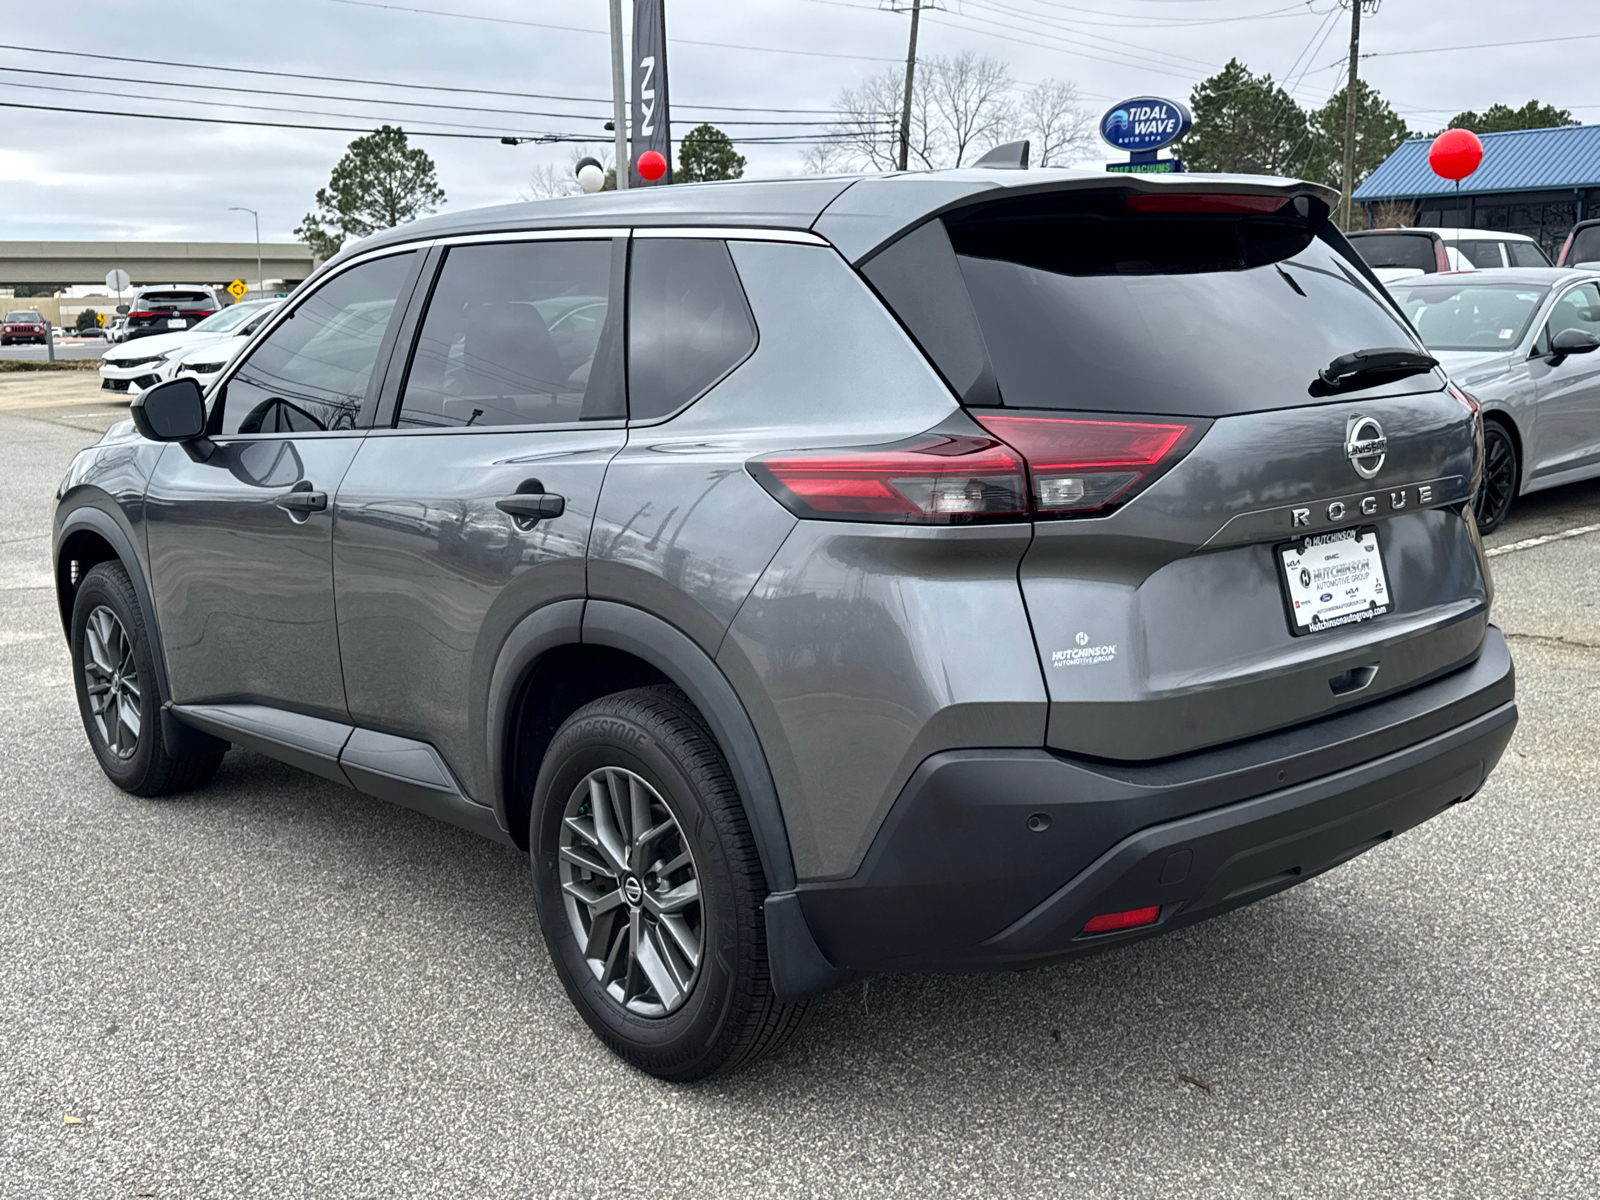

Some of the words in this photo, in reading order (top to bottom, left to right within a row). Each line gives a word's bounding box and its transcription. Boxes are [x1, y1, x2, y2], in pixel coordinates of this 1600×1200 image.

[1129, 106, 1167, 121] TIDAL
[1134, 120, 1175, 135] WAVE
[1131, 163, 1170, 173] VACUUMS
[1292, 486, 1432, 527] ROGUE
[1313, 530, 1356, 546] HUTCHINSON
[1313, 558, 1371, 583] HUTCHINSON
[1316, 576, 1350, 591] AUTOMOTIVE
[1351, 571, 1370, 583] GROUP
[1309, 606, 1387, 632] Hutchinsonautogroup.com
[1052, 645, 1116, 660] HUTCHINSON
[1054, 657, 1092, 667] AUTOMOTIVE
[1093, 655, 1114, 663] GROUP
